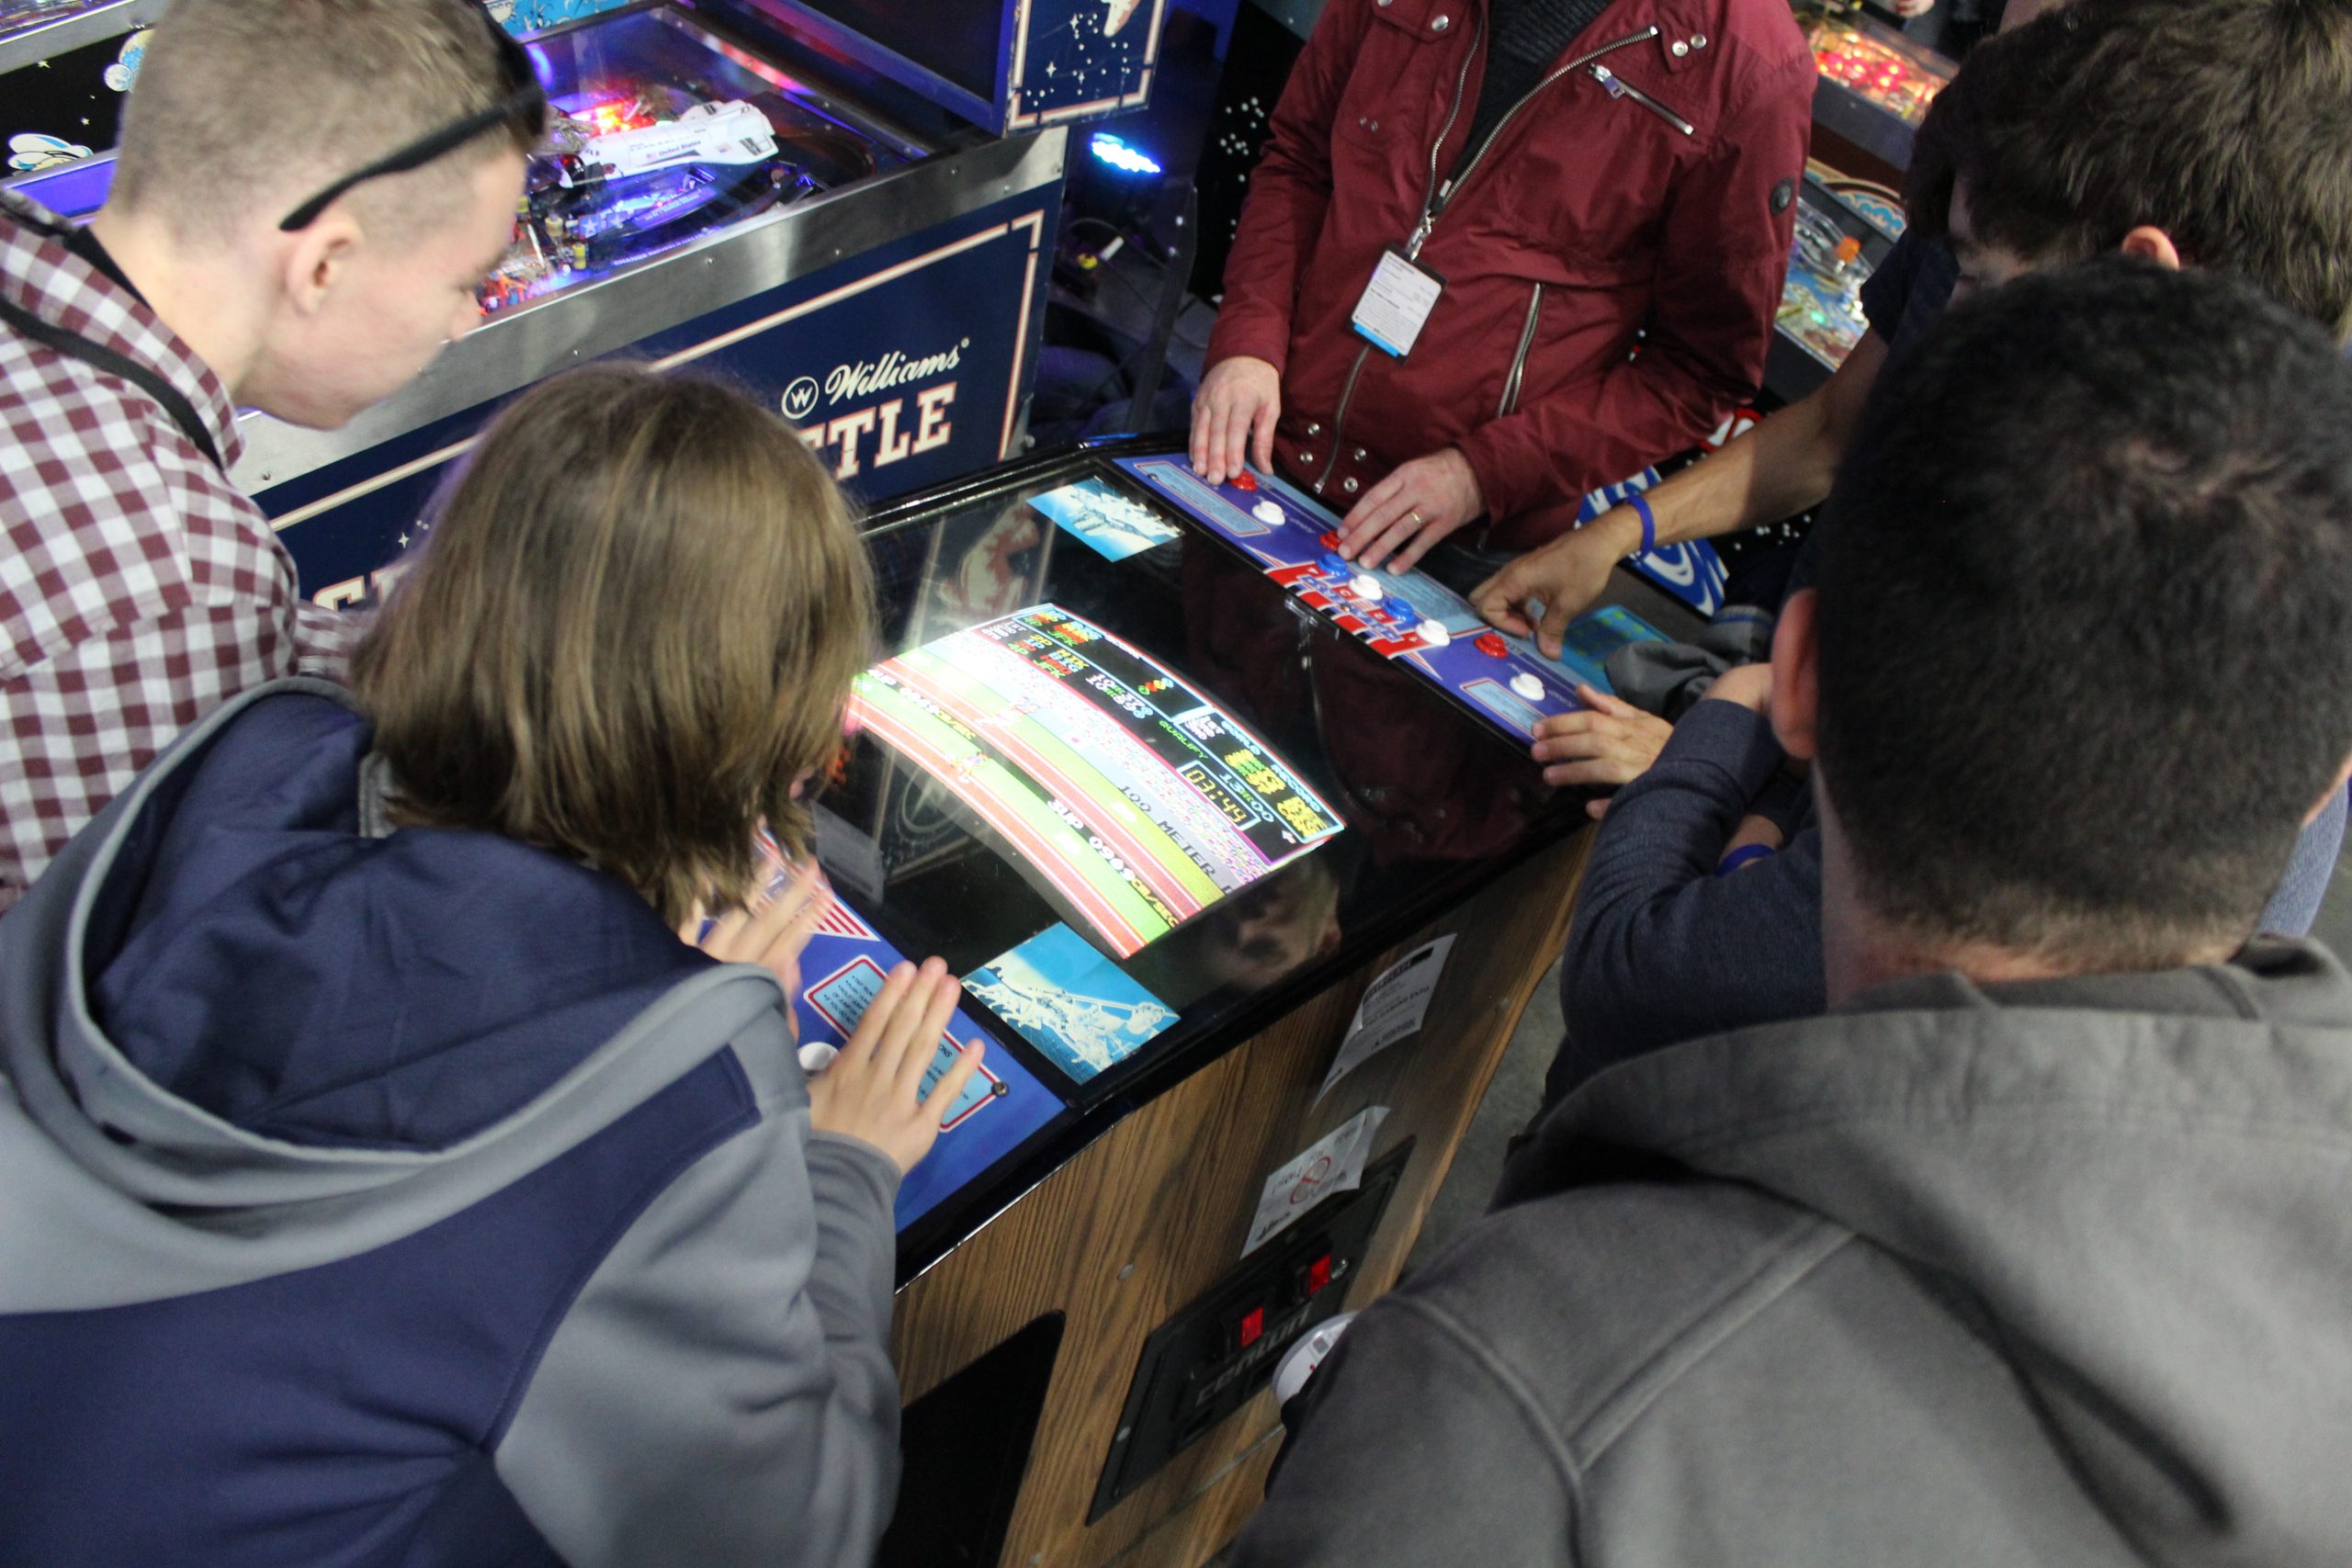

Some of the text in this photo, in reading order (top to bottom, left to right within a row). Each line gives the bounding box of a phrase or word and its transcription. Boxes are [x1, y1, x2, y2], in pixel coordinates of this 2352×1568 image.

[824, 344, 961, 406] Williams
[1159, 719, 1208, 760] QUALIFY
[1117, 785, 1153, 813] 100
[1157, 819, 1217, 877] METER
